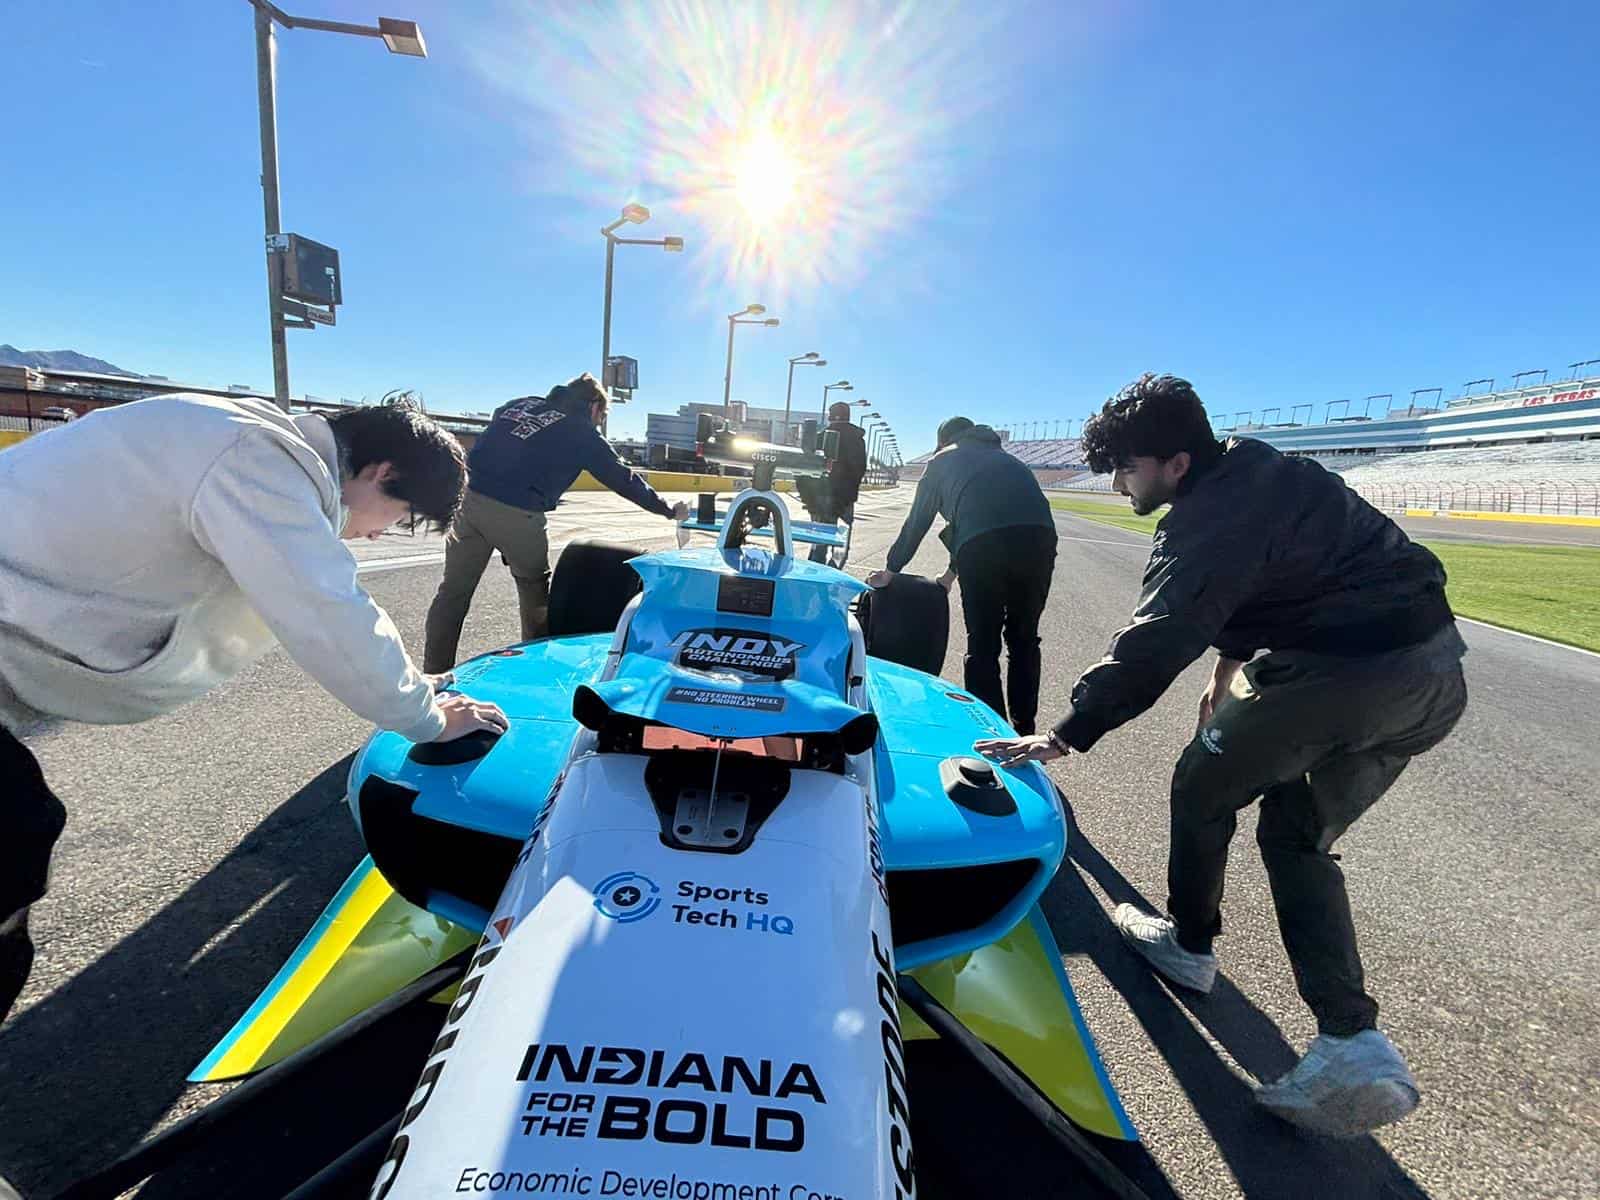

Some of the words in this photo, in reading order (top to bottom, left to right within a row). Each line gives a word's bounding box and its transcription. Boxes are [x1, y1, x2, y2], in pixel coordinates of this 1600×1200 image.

[1523, 396, 1547, 406] LAS
[1553, 389, 1597, 402] VEGAS
[670, 631, 803, 657] INDY
[683, 647, 791, 664] AUTONOMOUS
[687, 654, 784, 668] CHALLENGE
[675, 689, 697, 697] #NO
[698, 692, 744, 701] STEERING
[747, 695, 779, 704] WHEEL
[713, 698, 756, 707] PROBLEM
[677, 880, 769, 905] Sports
[672, 904, 737, 929] Tech
[745, 911, 794, 936] HQ
[516, 1043, 828, 1105] INDIANA
[526, 1092, 596, 1113] FOR
[520, 1115, 590, 1138] THE
[597, 1095, 805, 1153] BOLD
[456, 1167, 593, 1195] Economic
[600, 1170, 781, 1200] Development
